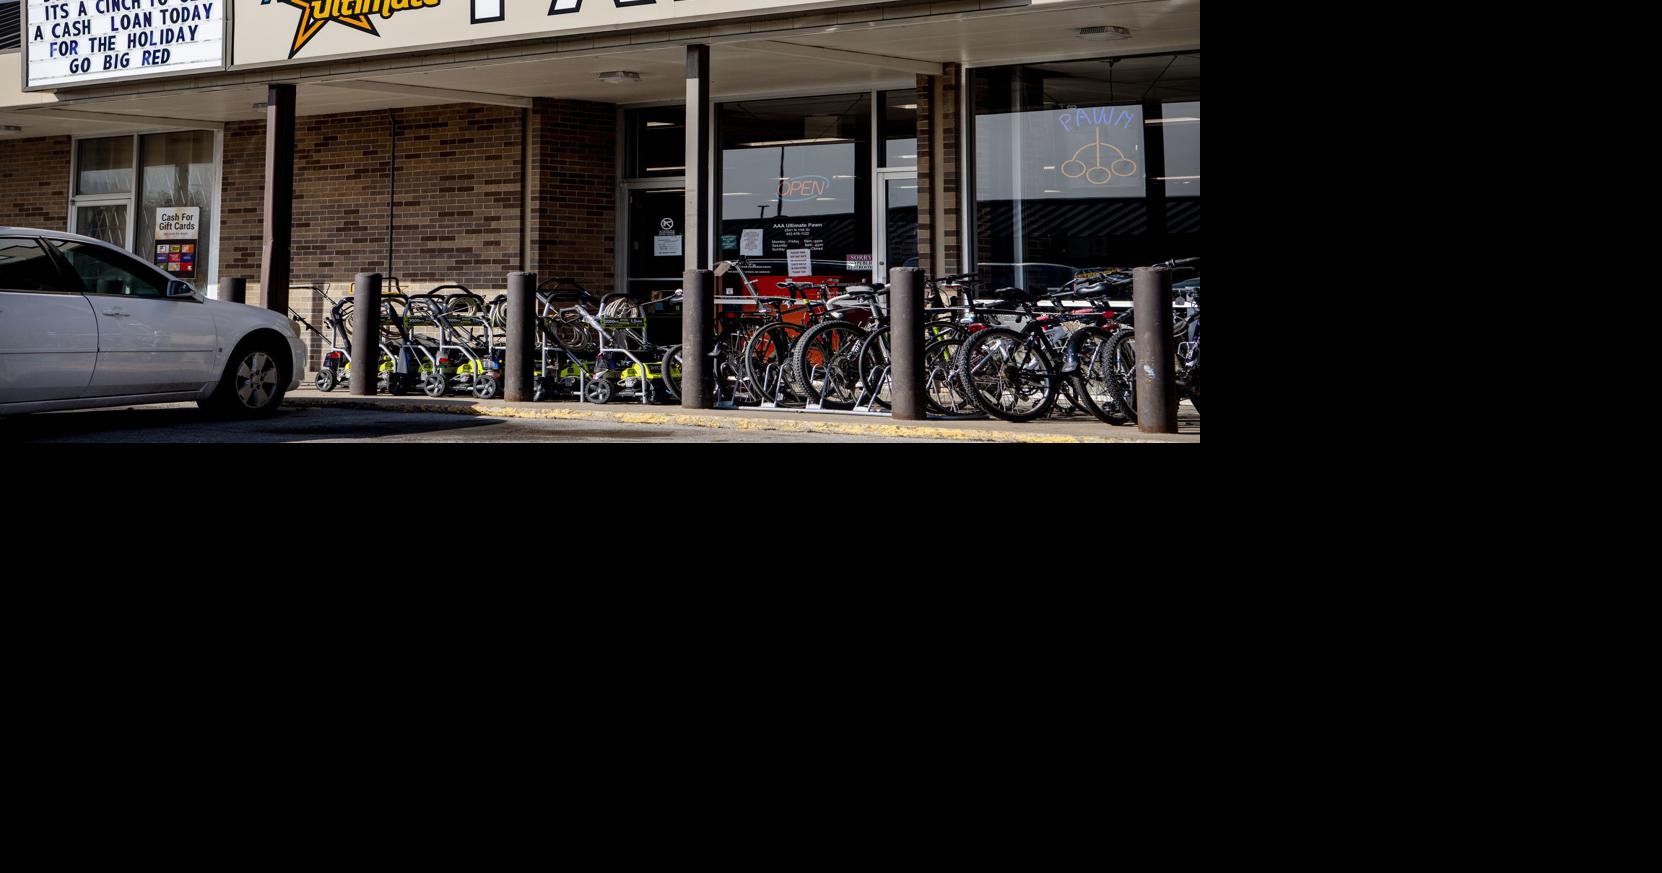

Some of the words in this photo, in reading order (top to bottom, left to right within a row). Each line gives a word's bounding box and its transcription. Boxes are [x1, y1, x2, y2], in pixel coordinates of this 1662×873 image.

[34, 25, 44, 41] A
[51, 19, 91, 39] CASH
[111, 11, 151, 32] LOAN
[160, 3, 213, 25] TODAY
[45, 3, 69, 21] ITS
[78, 1, 88, 17] A
[49, 40, 79, 58] FOR
[88, 35, 117, 53] THE
[127, 25, 198, 49] HOLIDAY
[69, 57, 91, 74] GO
[103, 53, 130, 70] BIG
[141, 48, 171, 66] RED
[1058, 106, 1135, 133] PAWN
[777, 180, 826, 197] OPEN
[159, 222, 173, 231] Gift
[174, 222, 196, 231] Cards
[161, 213, 180, 222] Cash
[181, 212, 194, 221] For
